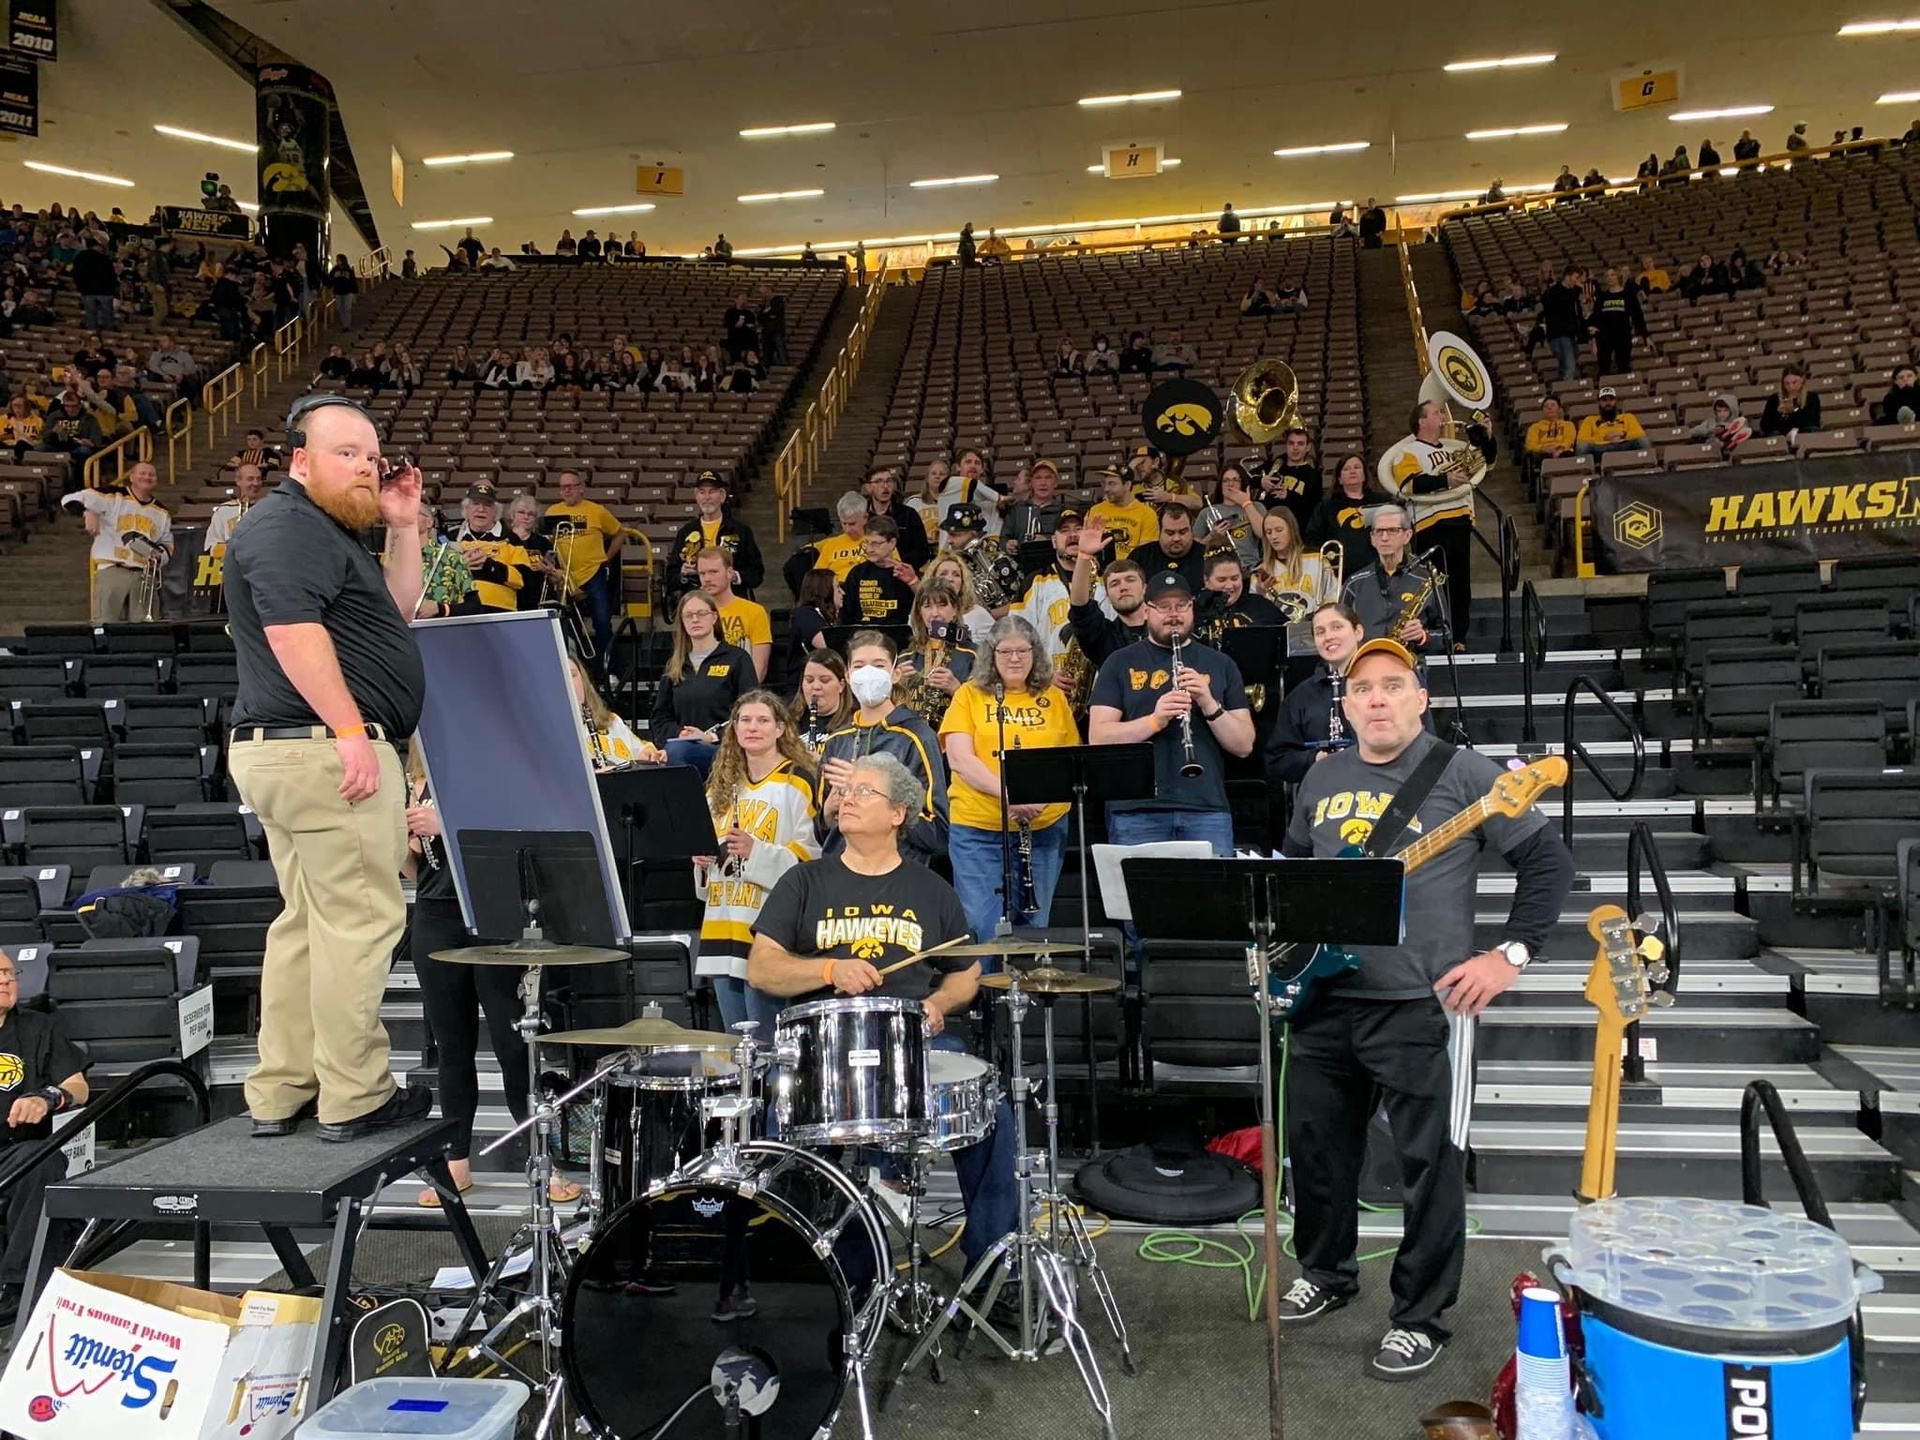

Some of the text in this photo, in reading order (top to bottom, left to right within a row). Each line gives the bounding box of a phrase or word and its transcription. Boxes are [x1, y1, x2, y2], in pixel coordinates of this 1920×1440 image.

[13, 31, 54, 52] 2010
[1642, 81, 1655, 96] G
[0, 110, 33, 128] 2011
[1126, 153, 1140, 167] H
[178, 209, 218, 221] HAWKS
[180, 217, 219, 232] NEST
[1705, 535, 1726, 544] THE
[1736, 528, 1797, 542] OFFICIAL
[1806, 523, 1865, 535] STUDENT
[1313, 791, 1423, 834] IOW
[826, 904, 916, 922] IOWA
[815, 916, 923, 954] HAWKEYES
[184, 1002, 211, 1027] RESERVED FOR
[189, 1017, 208, 1036] PEP BAND
[56, 1296, 182, 1351] World Famous Fruit
[64, 1333, 178, 1409] Stemilt
[256, 1390, 297, 1415] Stemilt
[1731, 1378, 1768, 1440] PO
